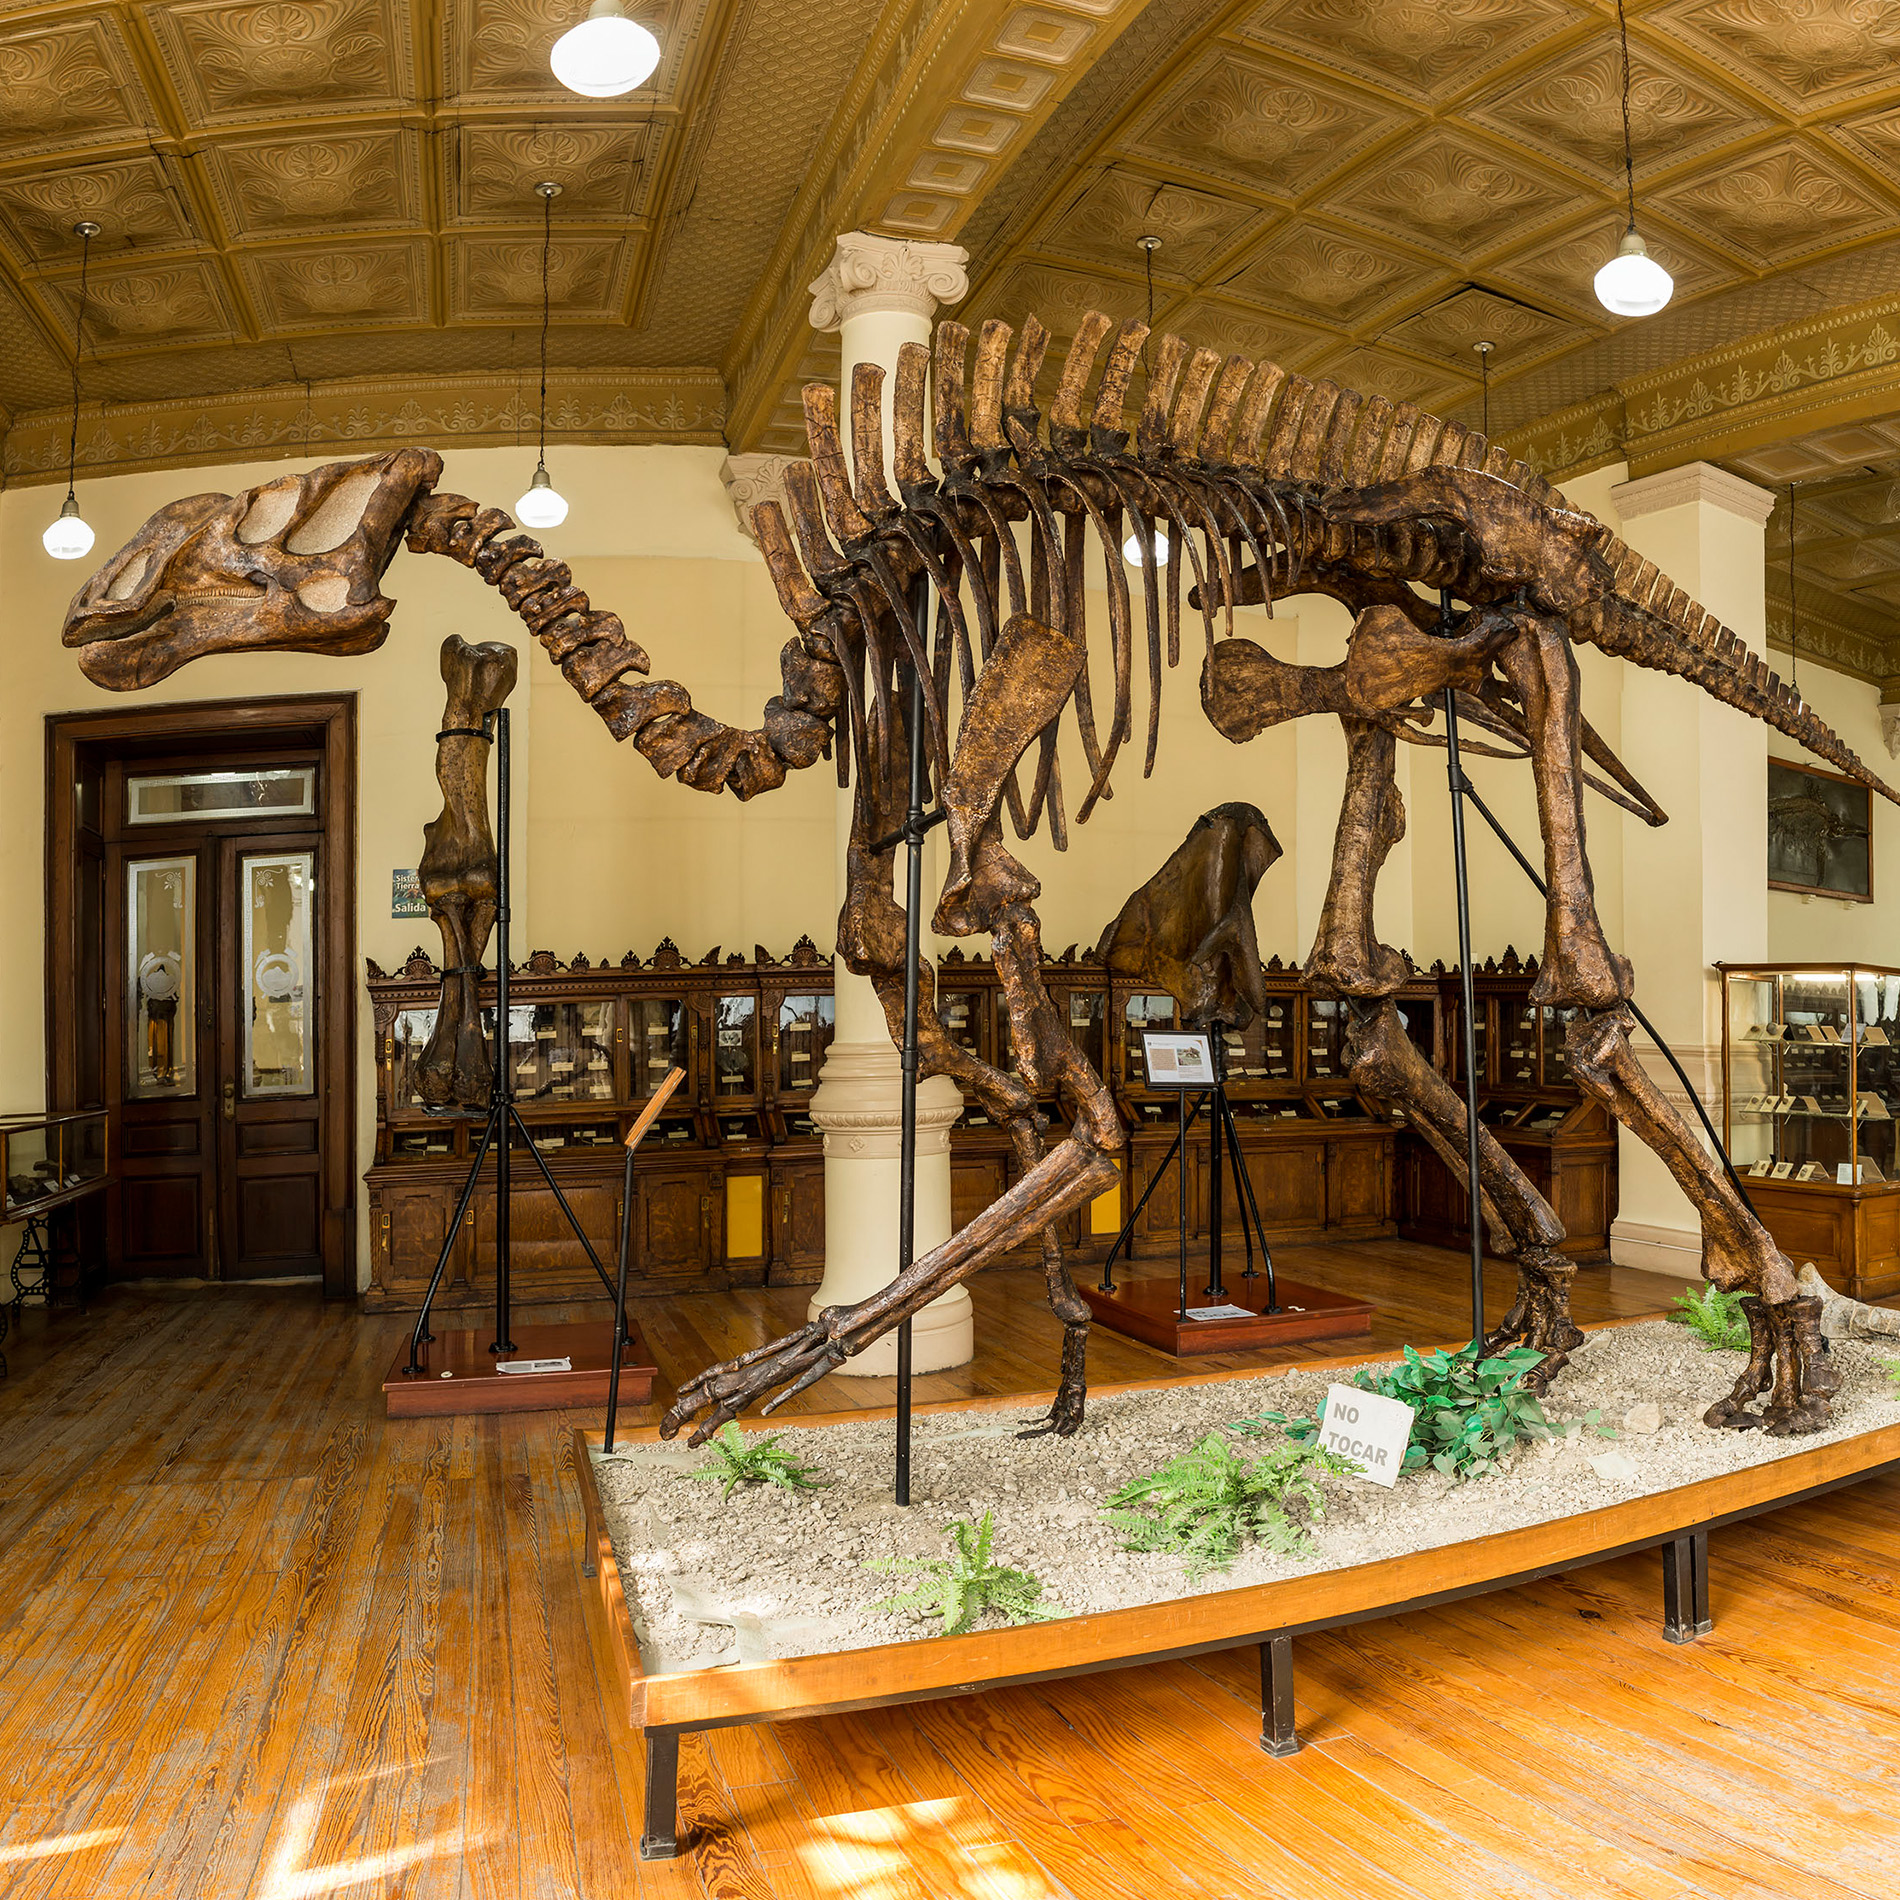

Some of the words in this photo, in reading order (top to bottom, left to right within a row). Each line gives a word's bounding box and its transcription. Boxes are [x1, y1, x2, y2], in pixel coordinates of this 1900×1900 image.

[396, 882, 420, 890] Tierra
[395, 902, 426, 913] Salida
[1333, 1402, 1360, 1424] NO
[1328, 1431, 1389, 1467] TOCAR
